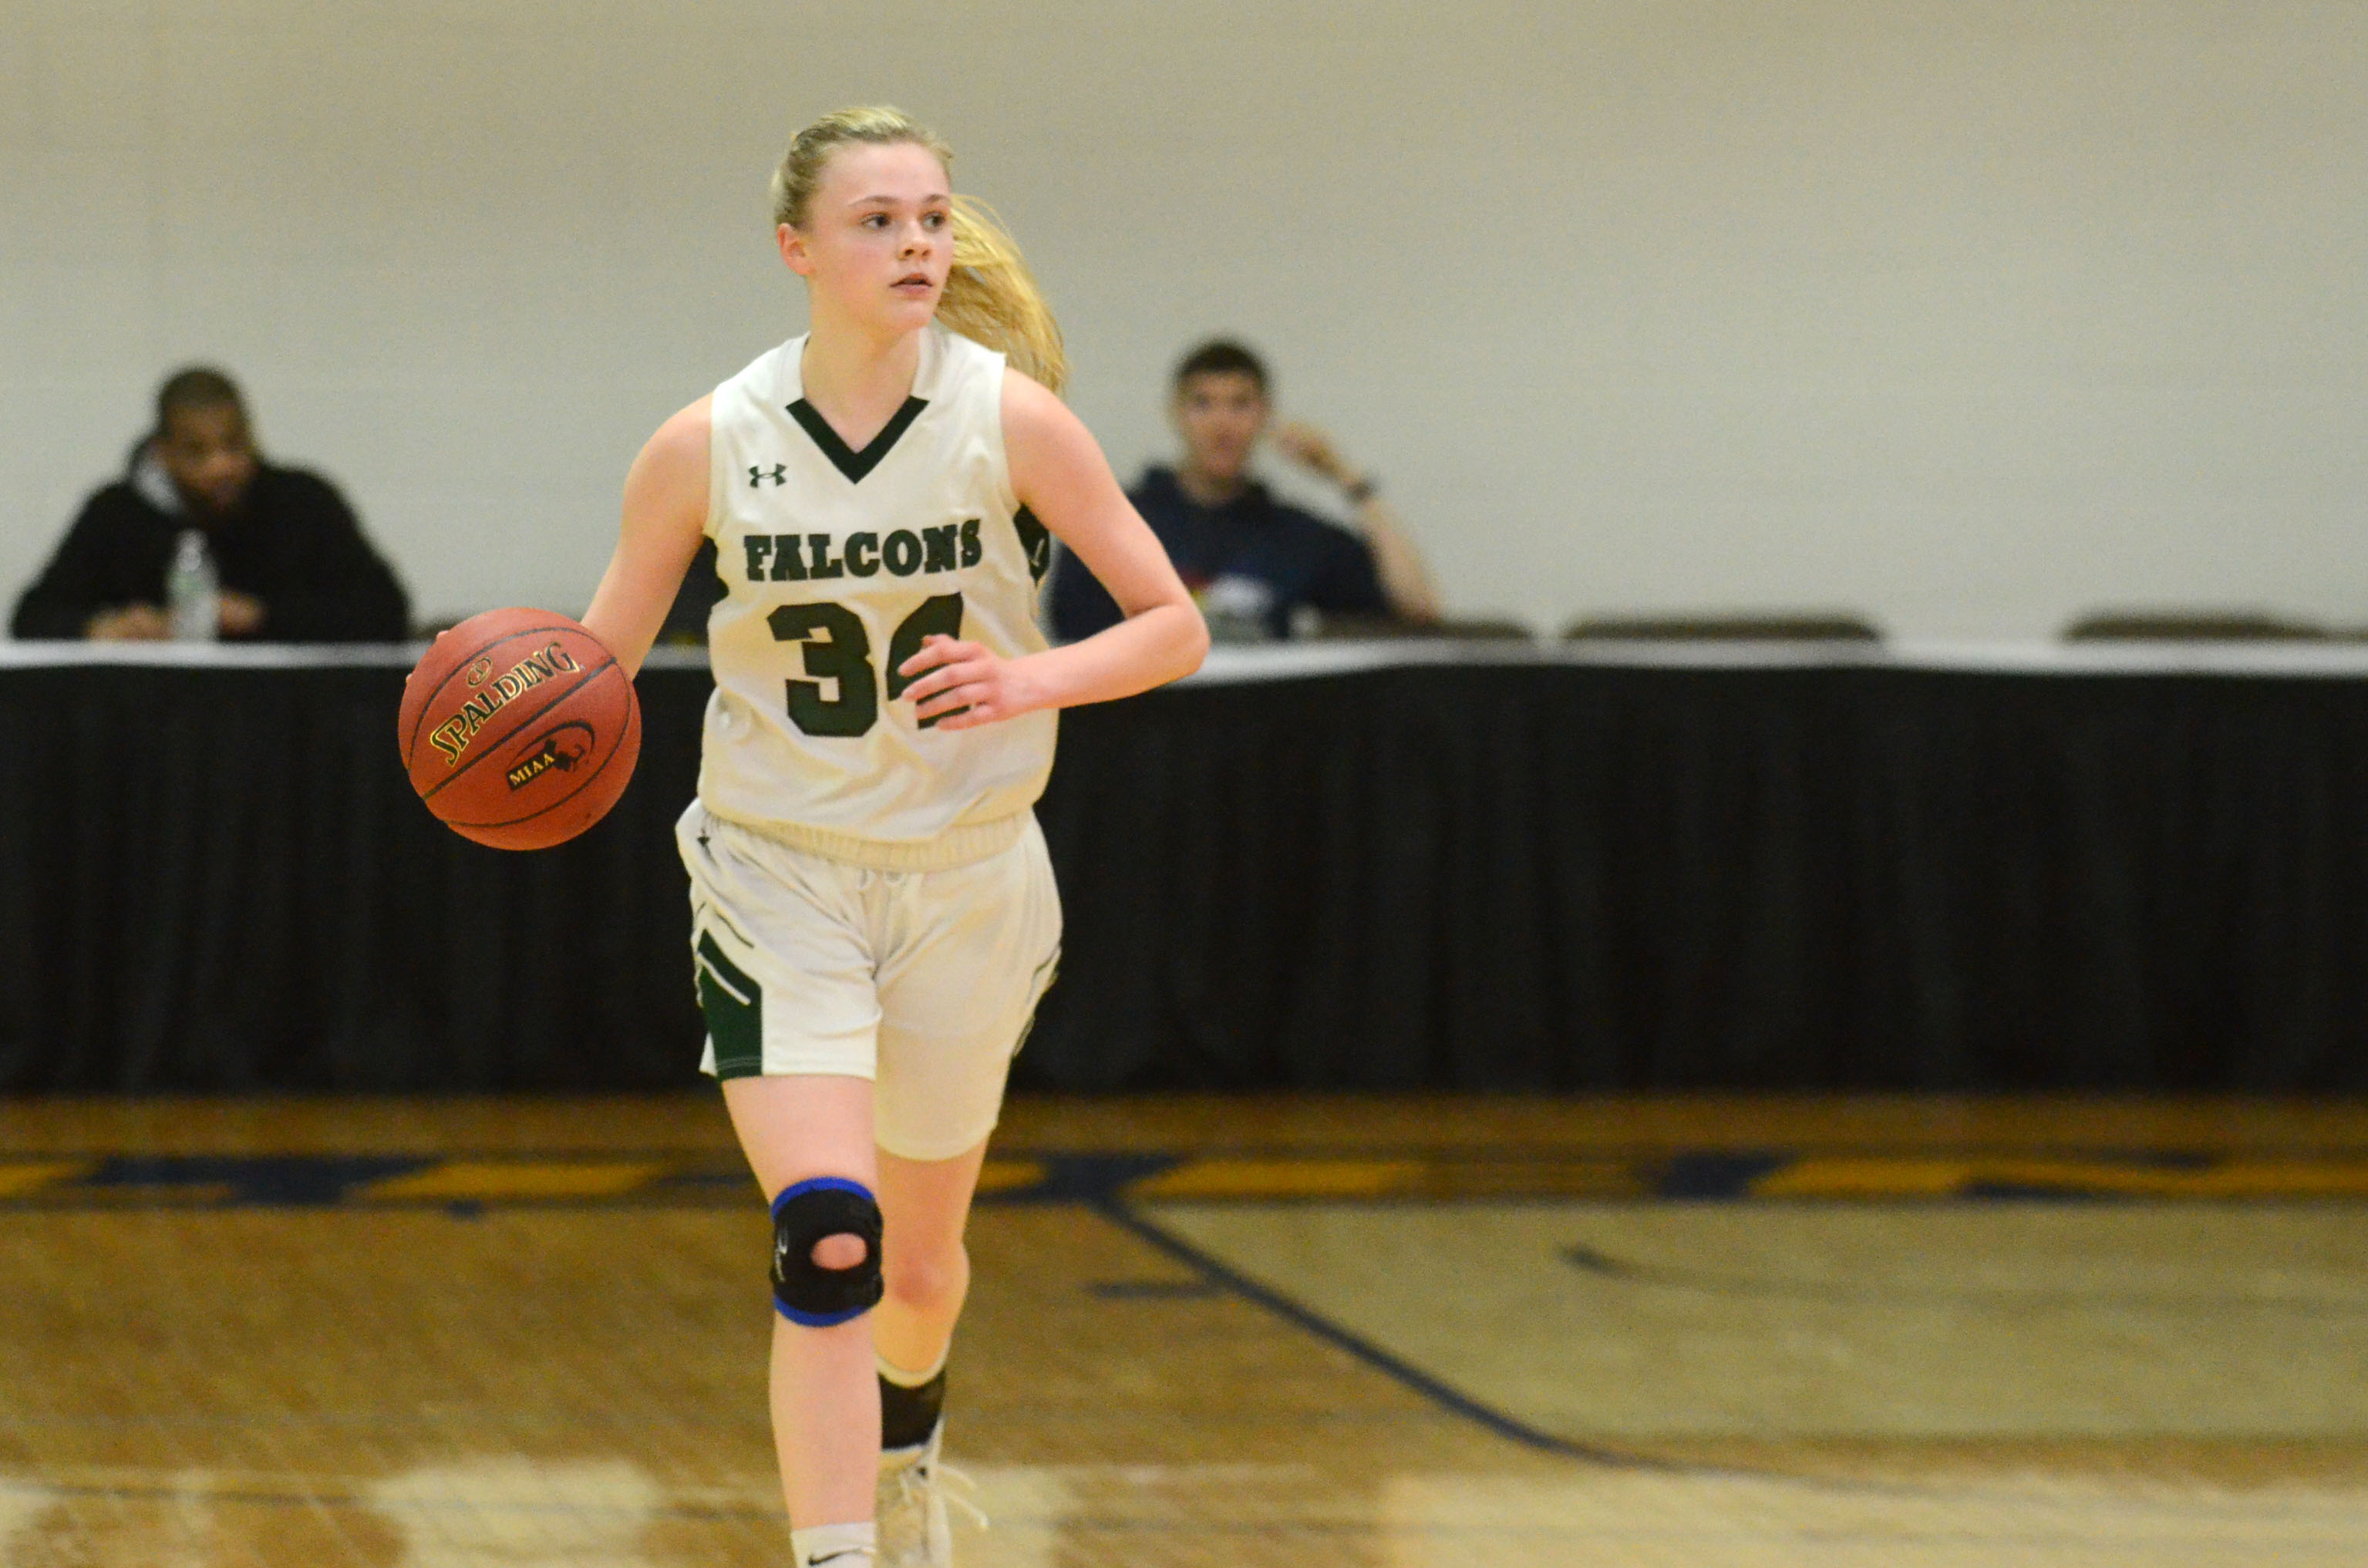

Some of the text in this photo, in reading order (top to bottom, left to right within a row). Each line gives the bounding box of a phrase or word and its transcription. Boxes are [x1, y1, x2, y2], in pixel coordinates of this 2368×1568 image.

[743, 519, 982, 581] FALCONS
[429, 641, 580, 767] SPALDING
[509, 752, 555, 786] MIAA
